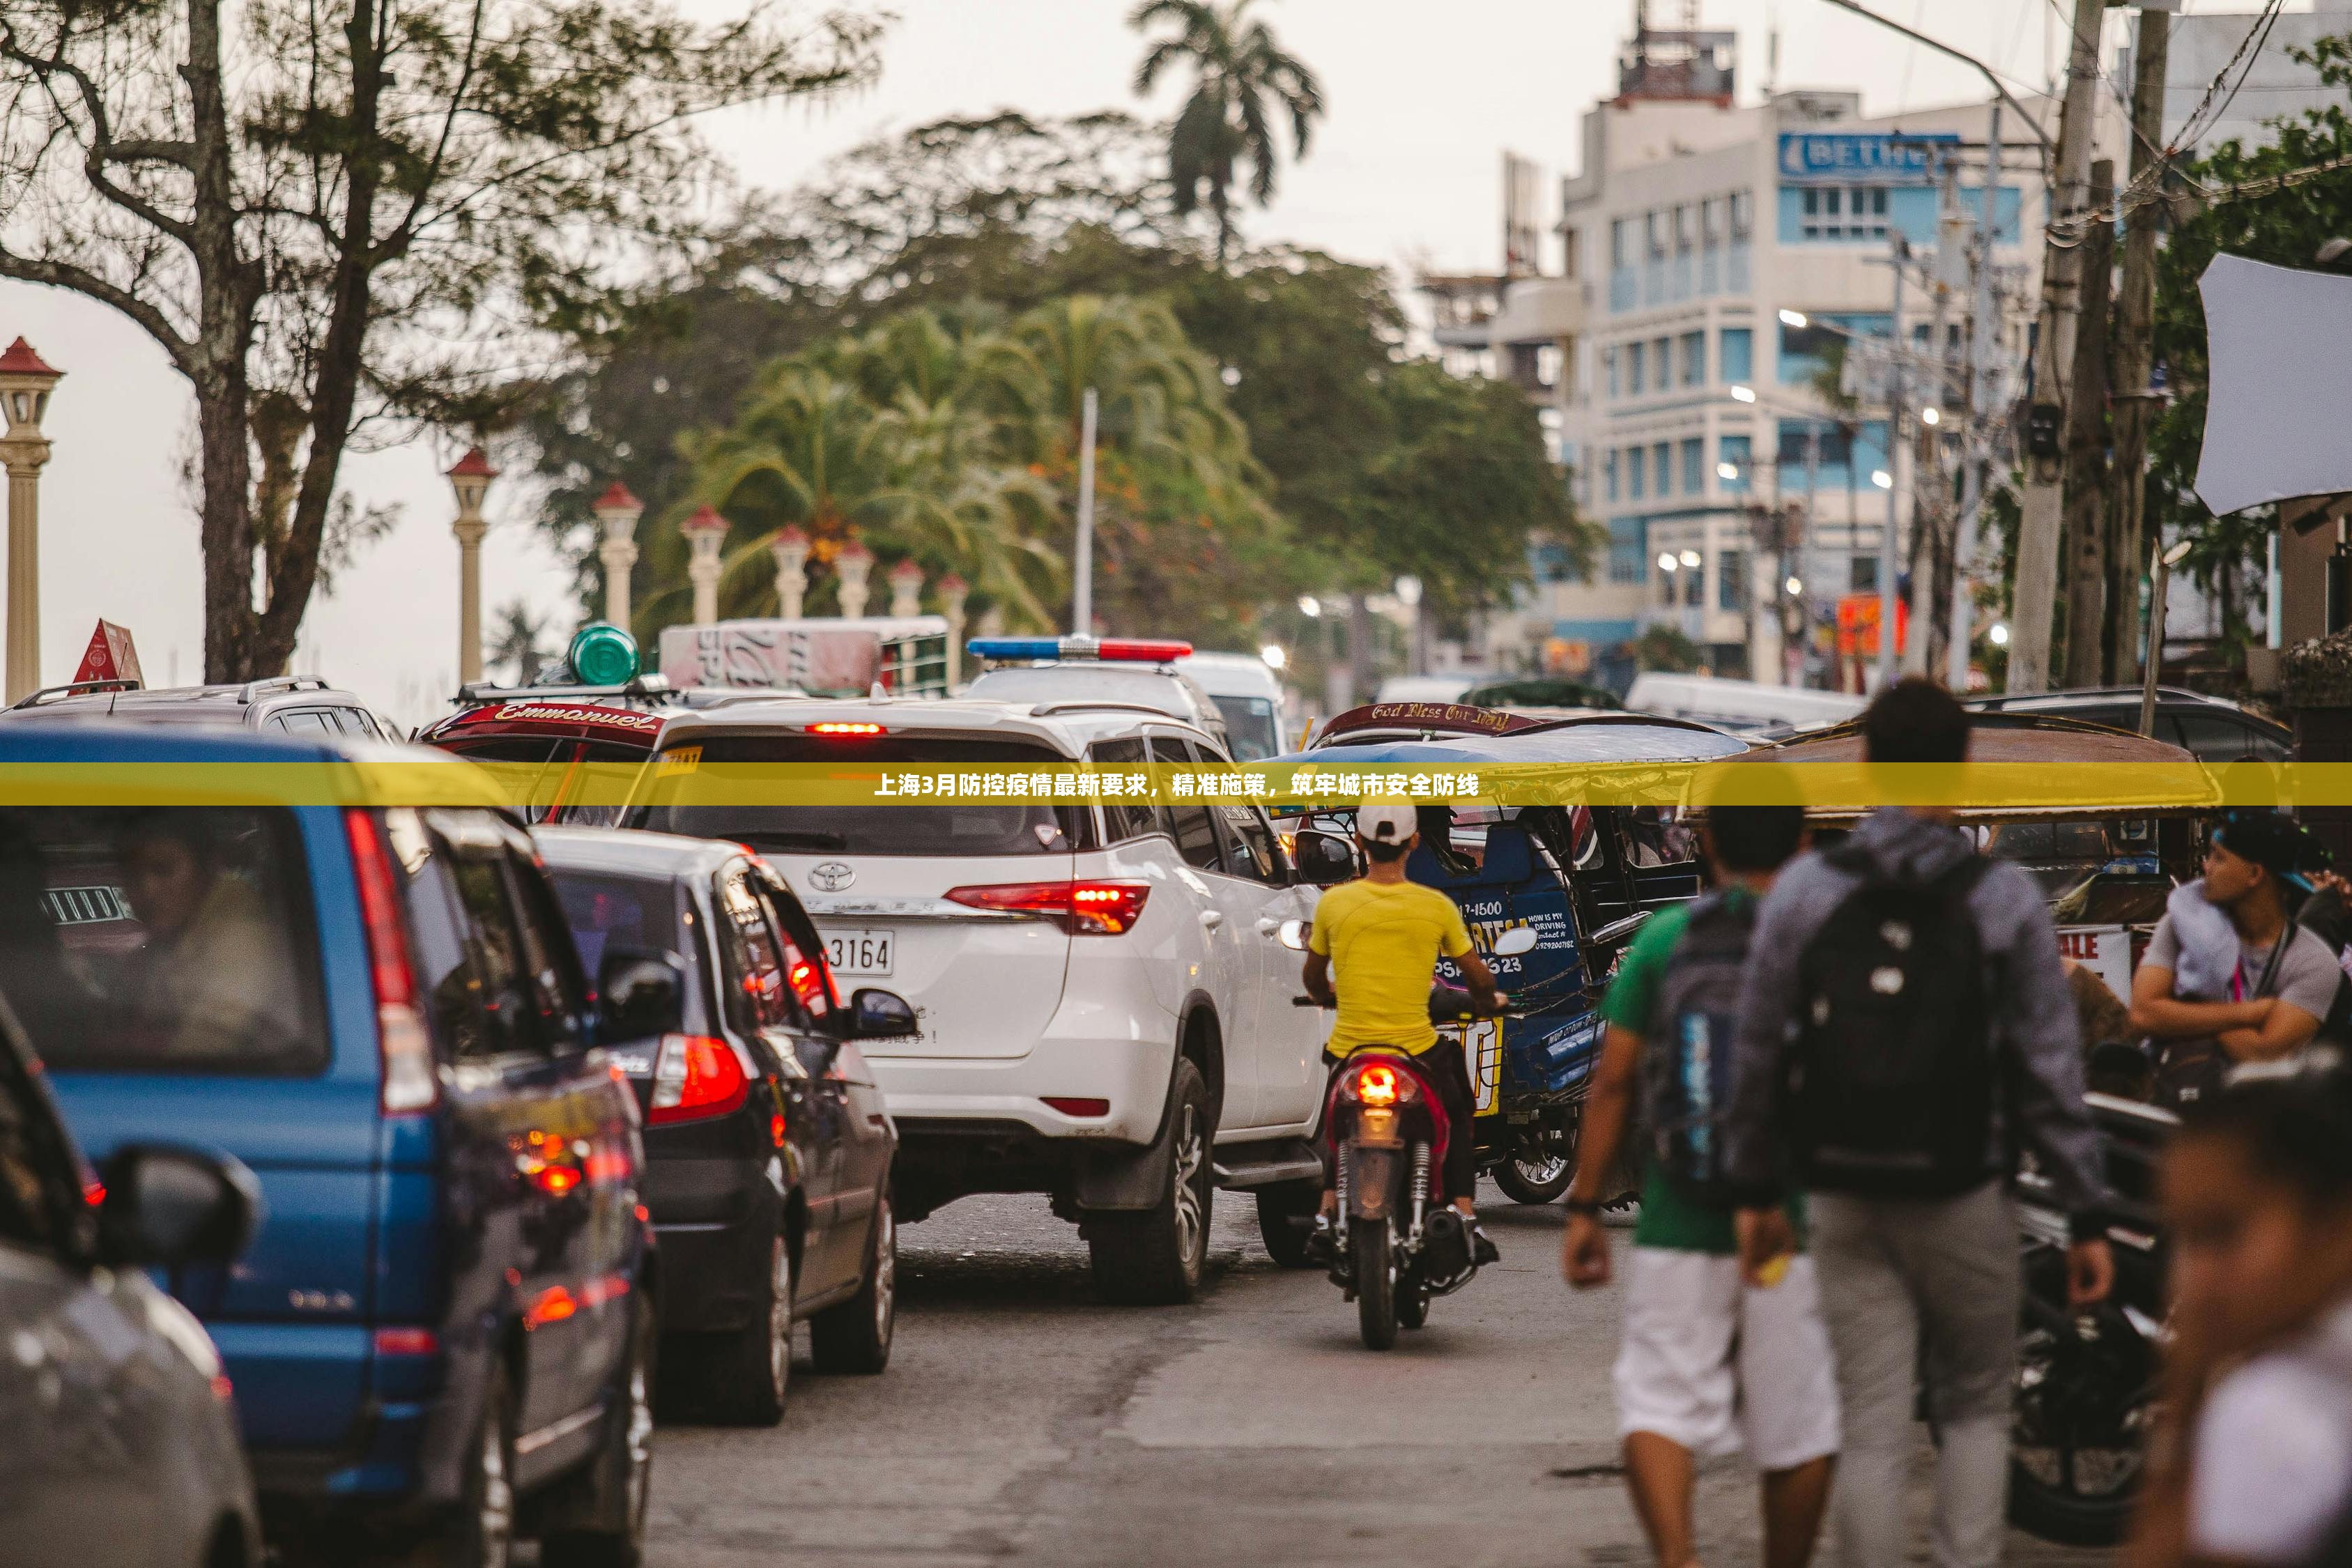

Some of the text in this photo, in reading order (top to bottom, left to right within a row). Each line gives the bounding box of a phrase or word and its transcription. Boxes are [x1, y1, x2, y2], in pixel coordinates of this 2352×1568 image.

[495, 703, 656, 730] Emmanuel
[1372, 704, 1404, 719] God
[1404, 703, 1443, 718] Bless
[1445, 705, 1469, 721] Our
[1528, 914, 1544, 923] HOW
[1535, 921, 1567, 931] DRIVING
[1537, 931, 1560, 939] ontact
[831, 939, 889, 969] 3164
[1502, 957, 1522, 974] 23
